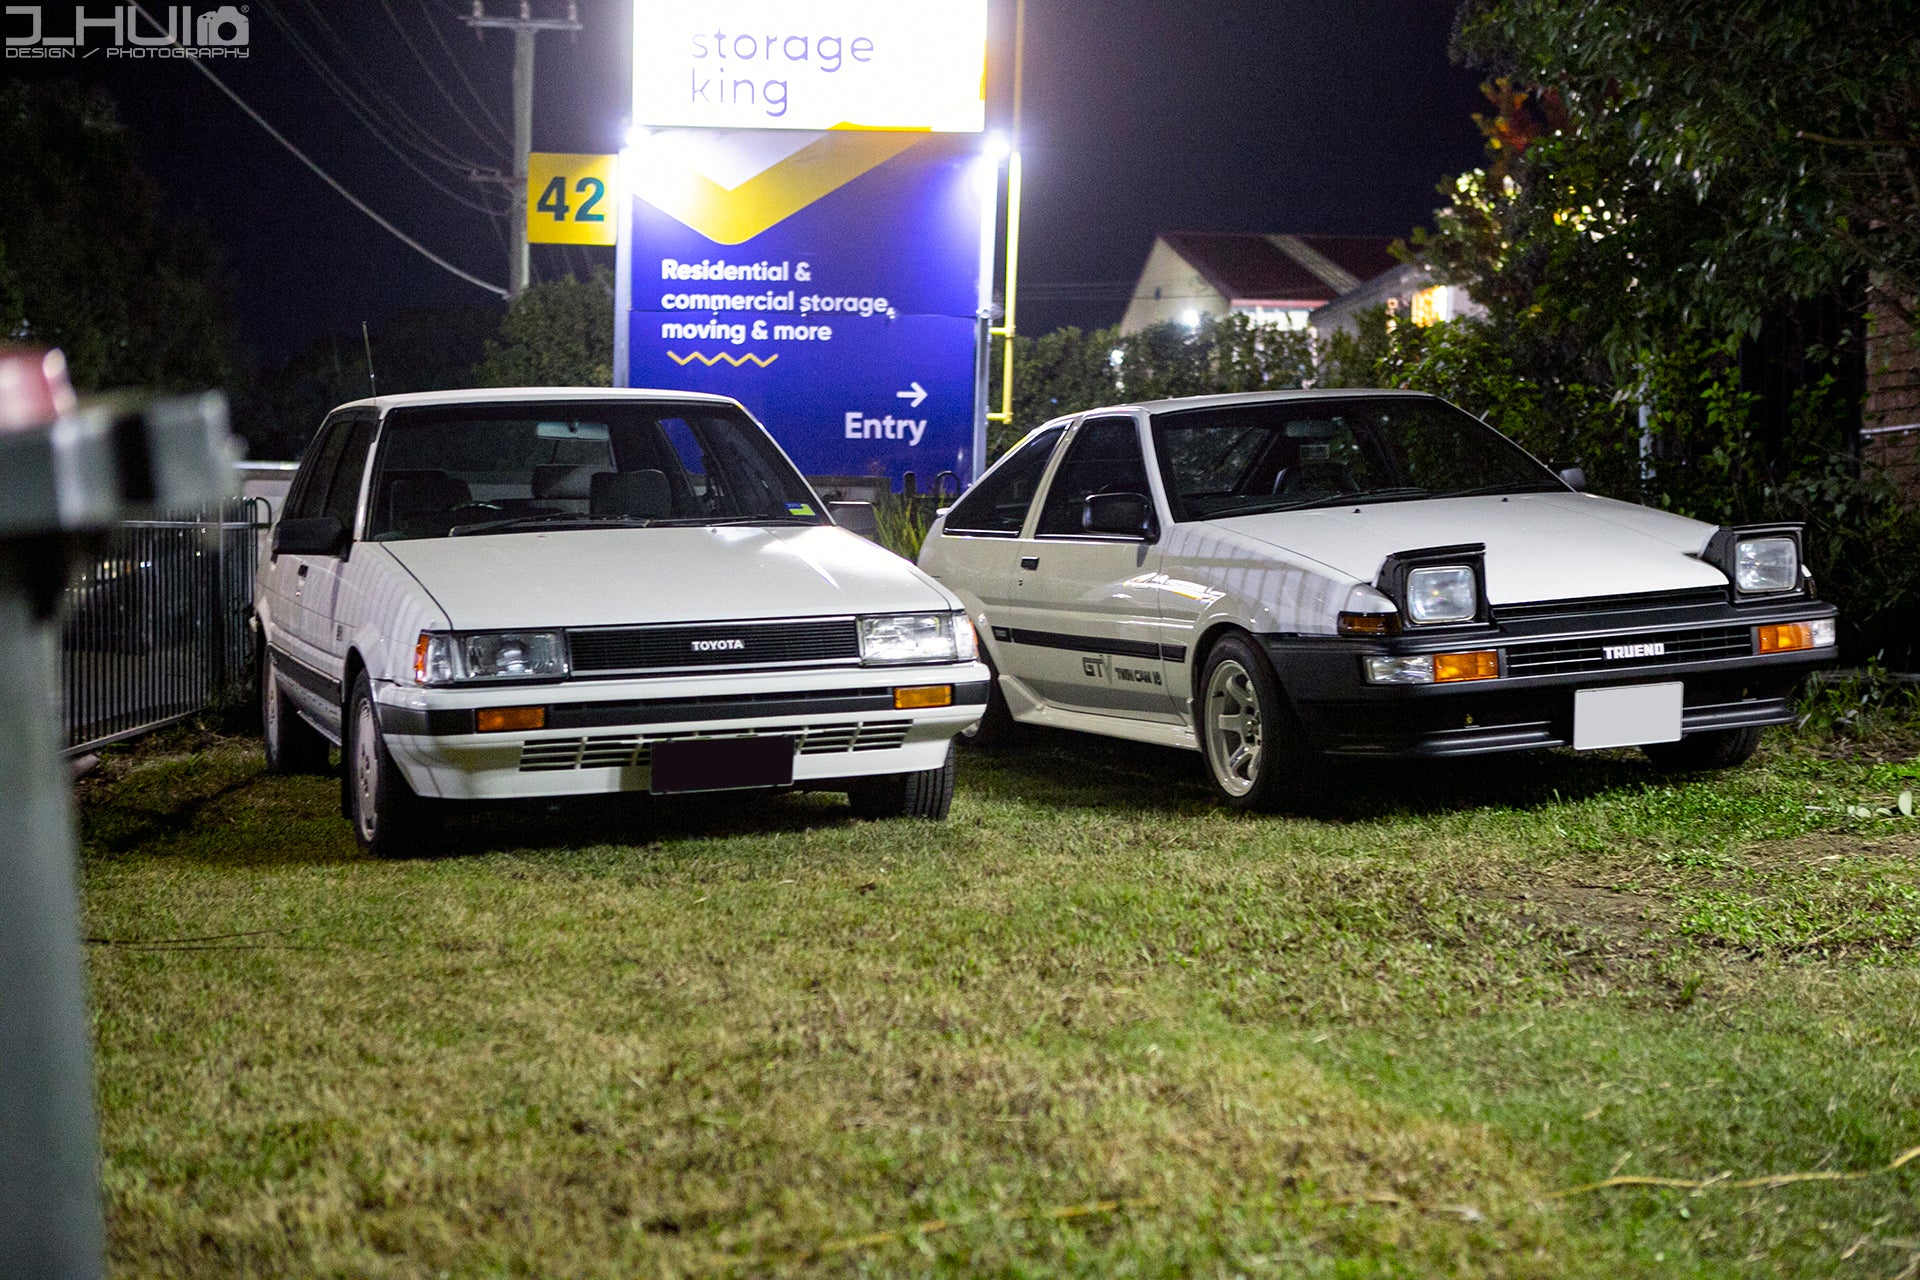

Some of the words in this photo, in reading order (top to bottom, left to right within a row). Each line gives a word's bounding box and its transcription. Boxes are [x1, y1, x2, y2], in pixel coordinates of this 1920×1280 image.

[692, 28, 874, 72] storage
[692, 67, 788, 117] king
[537, 176, 605, 222] 42
[661, 258, 789, 281] Residential
[794, 262, 811, 281] &
[661, 290, 795, 311] commercial
[799, 294, 896, 319] storage,
[661, 319, 746, 345] moving
[751, 319, 768, 340] &
[773, 325, 832, 340] more
[845, 412, 927, 446] Entry
[691, 639, 744, 651] TOYOTA
[1602, 642, 1665, 660] TRUENO
